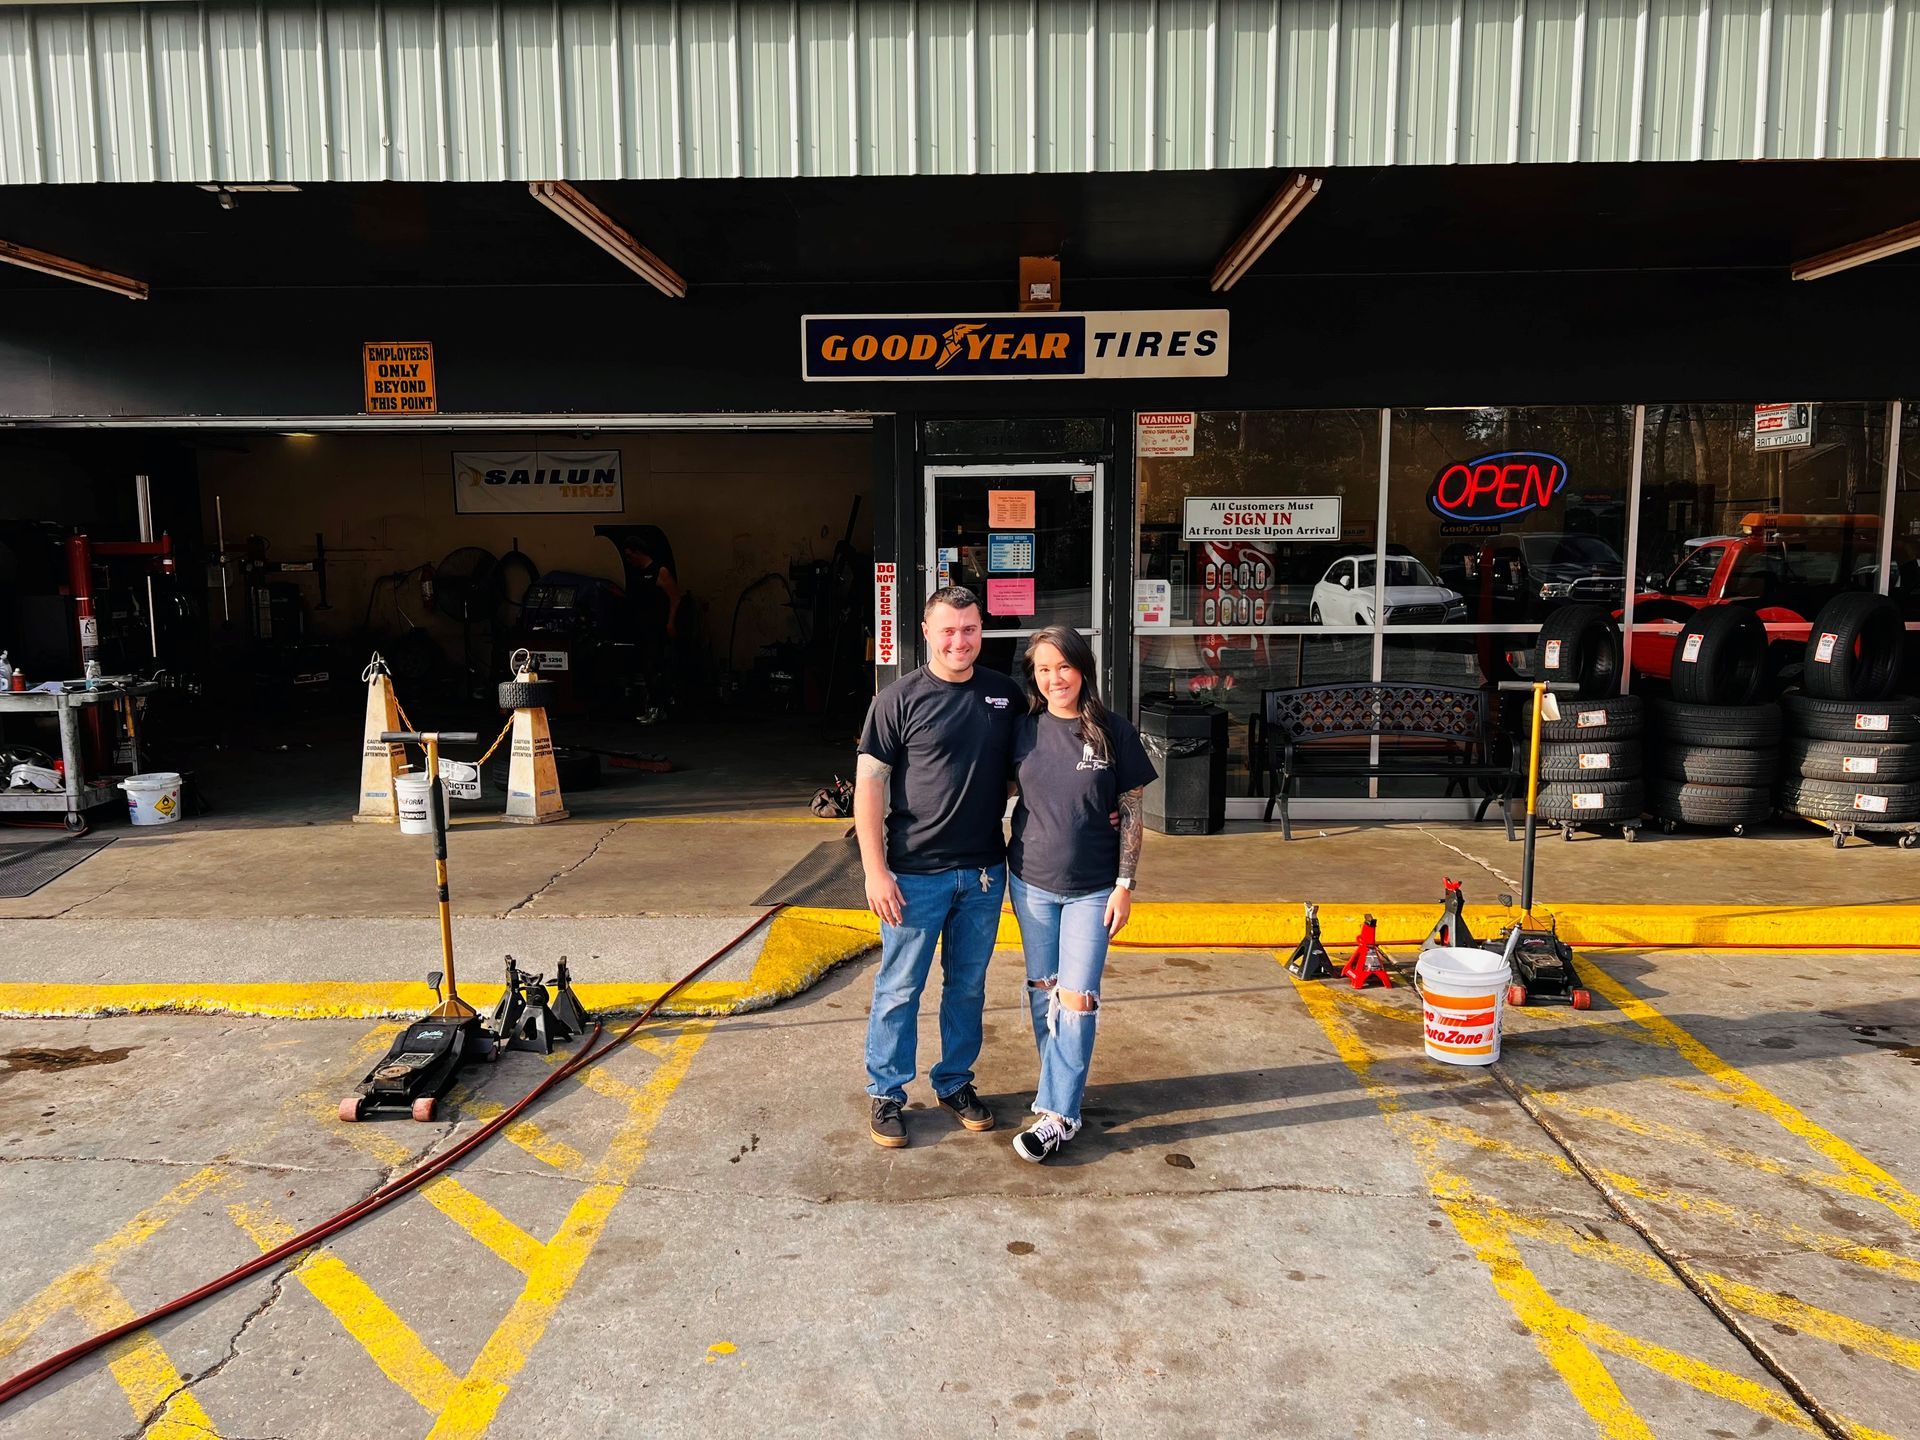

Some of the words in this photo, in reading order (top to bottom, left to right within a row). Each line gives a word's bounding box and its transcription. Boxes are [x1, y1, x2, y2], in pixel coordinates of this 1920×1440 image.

[821, 332, 1070, 361] GOODYEAR
[1093, 329, 1218, 358] TIRES
[368, 347, 430, 361] EMPLOYEES
[378, 364, 419, 378] ONLY
[374, 380, 427, 394] BEYOND
[370, 396, 398, 410] THIS
[400, 396, 433, 410] POINT
[1140, 415, 1190, 424] WARNING
[484, 468, 617, 485] SAILUN
[560, 485, 615, 498] TIRES
[1437, 464, 1558, 508] OPEN
[1210, 502, 1225, 511] All
[1228, 502, 1285, 511] Customers
[1287, 501, 1314, 510] Must
[1222, 512, 1267, 526] SIGN
[1272, 512, 1293, 526] IN
[1188, 527, 1201, 535] At
[1203, 527, 1232, 535] Front
[1235, 527, 1261, 535] Desk
[1264, 527, 1293, 537] Upon
[1296, 526, 1335, 535] Arrival
[877, 564, 895, 573] DO
[876, 574, 896, 583] NOT
[880, 585, 892, 616] BLOCK
[879, 619, 894, 664] DOORWAY
